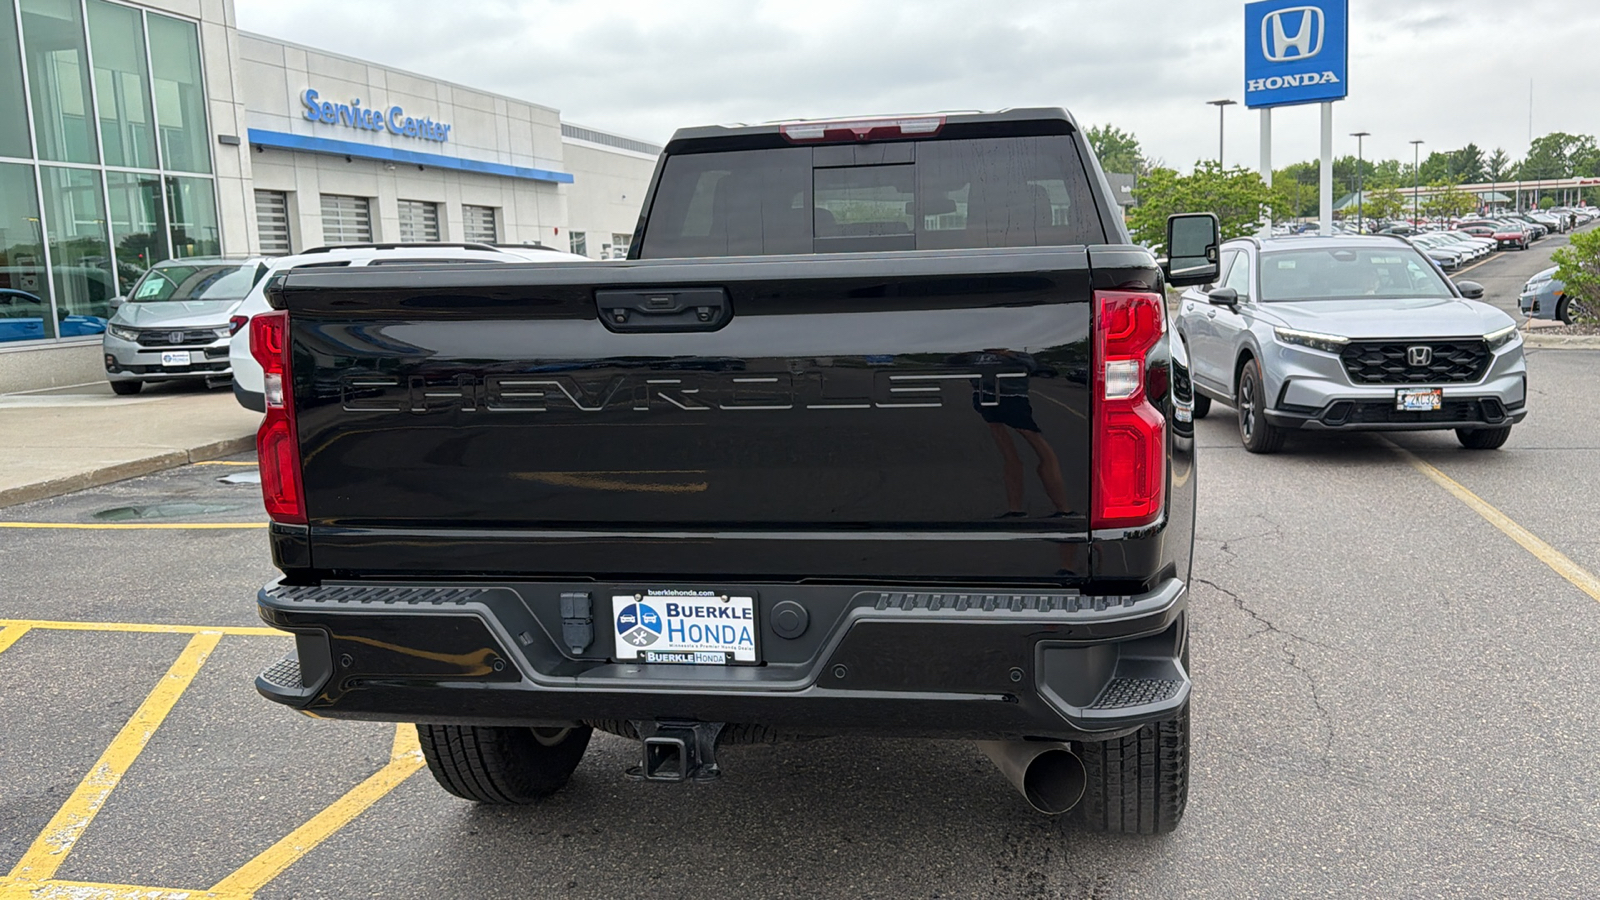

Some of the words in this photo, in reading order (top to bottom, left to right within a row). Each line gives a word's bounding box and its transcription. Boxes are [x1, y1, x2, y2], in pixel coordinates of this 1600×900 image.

[1247, 71, 1340, 92] HONDA
[300, 88, 384, 131] Service
[384, 105, 451, 142] Center
[340, 369, 1028, 412] CHEVROLET
[648, 589, 715, 597] buerklehonda.com
[666, 602, 752, 620] BUERKLE
[667, 619, 753, 646] HONDA
[649, 653, 694, 662] BUERKLE
[695, 653, 724, 662] HONDA
